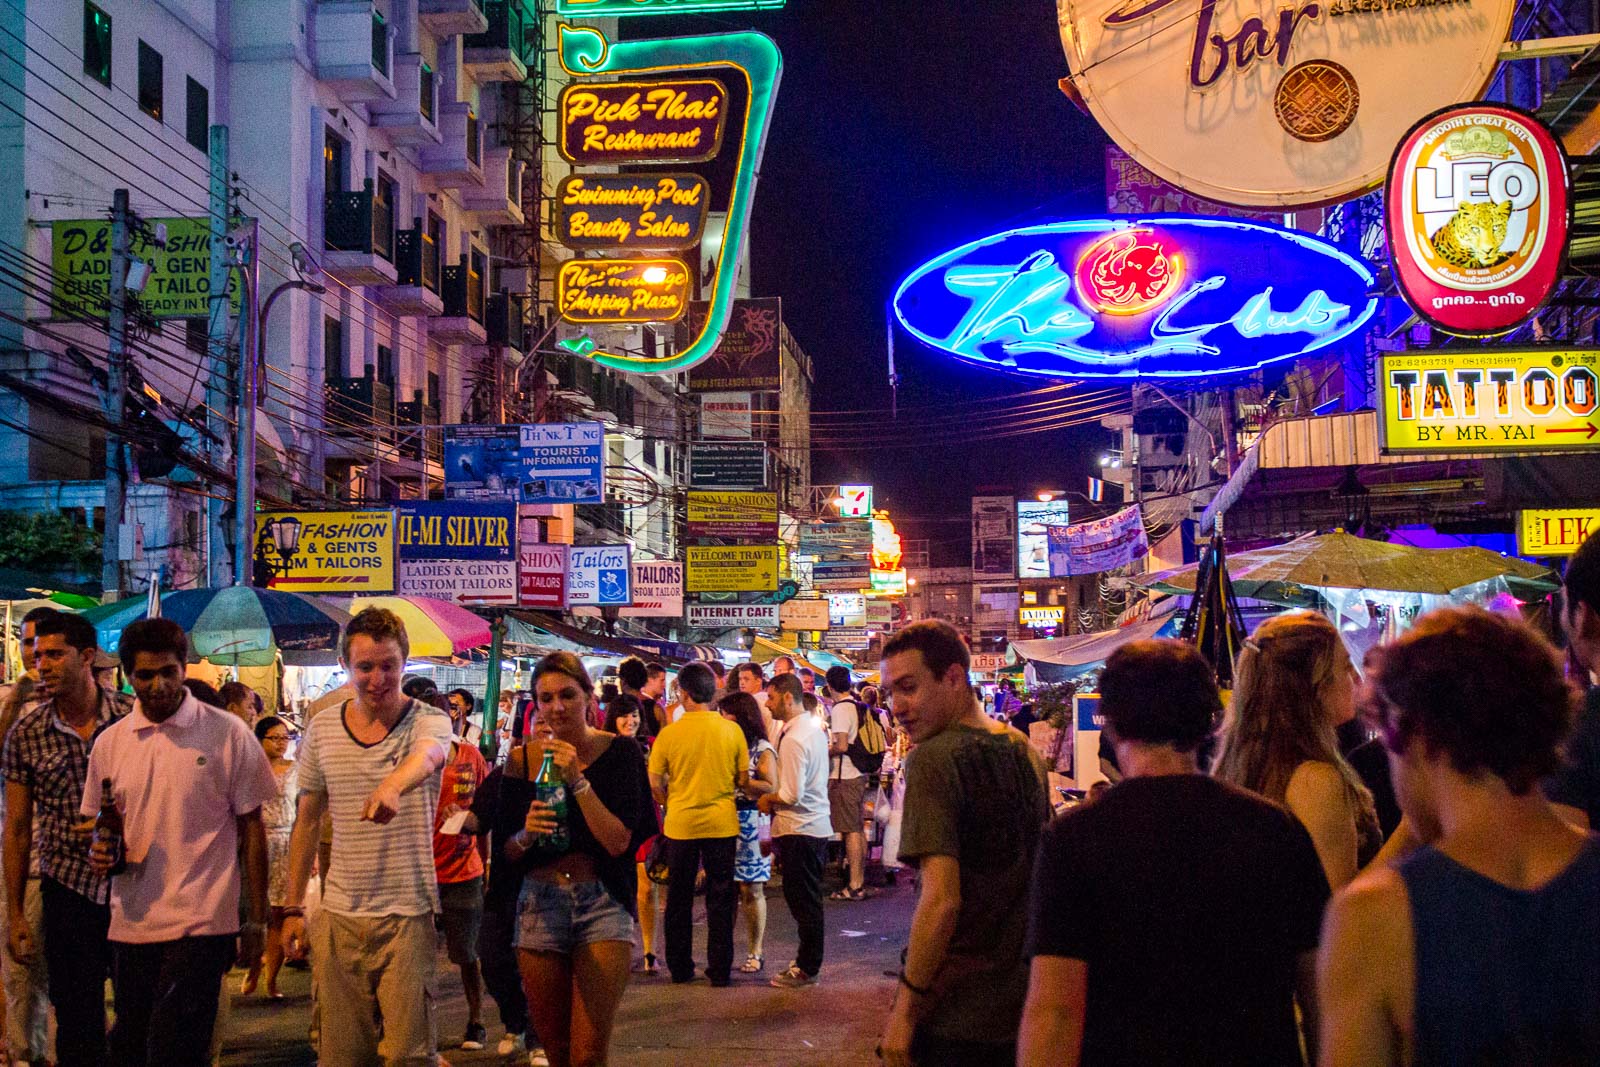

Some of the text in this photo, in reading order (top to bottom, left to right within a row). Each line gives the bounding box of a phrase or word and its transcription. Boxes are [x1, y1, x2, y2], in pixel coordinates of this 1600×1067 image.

[567, 88, 718, 124] Pick-Thai
[583, 124, 701, 151] Restaurant
[1424, 116, 1529, 145] SMOOTH & GREAT TASTE
[563, 178, 702, 211] Swimming Pool
[1416, 161, 1539, 214] LEO
[569, 211, 690, 242] Beauty Salon
[155, 277, 237, 295] TAILOS
[563, 288, 679, 316] Shopping Plaza
[945, 249, 1352, 351] The Club
[1389, 365, 1600, 421] TATTOO
[1417, 425, 1536, 441] BY MR. YAI
[533, 447, 589, 456] TOURIST
[522, 456, 599, 466] INFORMATION
[727, 495, 776, 505] FASHIONS
[847, 490, 865, 515] 7
[301, 522, 387, 538] FASHION
[446, 515, 510, 547] SILVER
[1541, 516, 1594, 546] LEK
[308, 542, 317, 553] &
[325, 541, 377, 553] GENTS
[499, 547, 509, 555] 74
[691, 550, 774, 560] WELCOME TRAVEL
[315, 556, 382, 569] TAILORS
[571, 549, 623, 569] Tailors
[406, 564, 509, 577] LADIES & GENTS
[637, 566, 681, 584] TAILORS
[402, 579, 456, 590] CUSTOM
[461, 578, 513, 589] TAILORS
[531, 576, 561, 588] TAILORS
[655, 587, 681, 597] TAILOR
[690, 607, 774, 618] INTERNET CAFE
[1022, 610, 1062, 619] INDIAN
